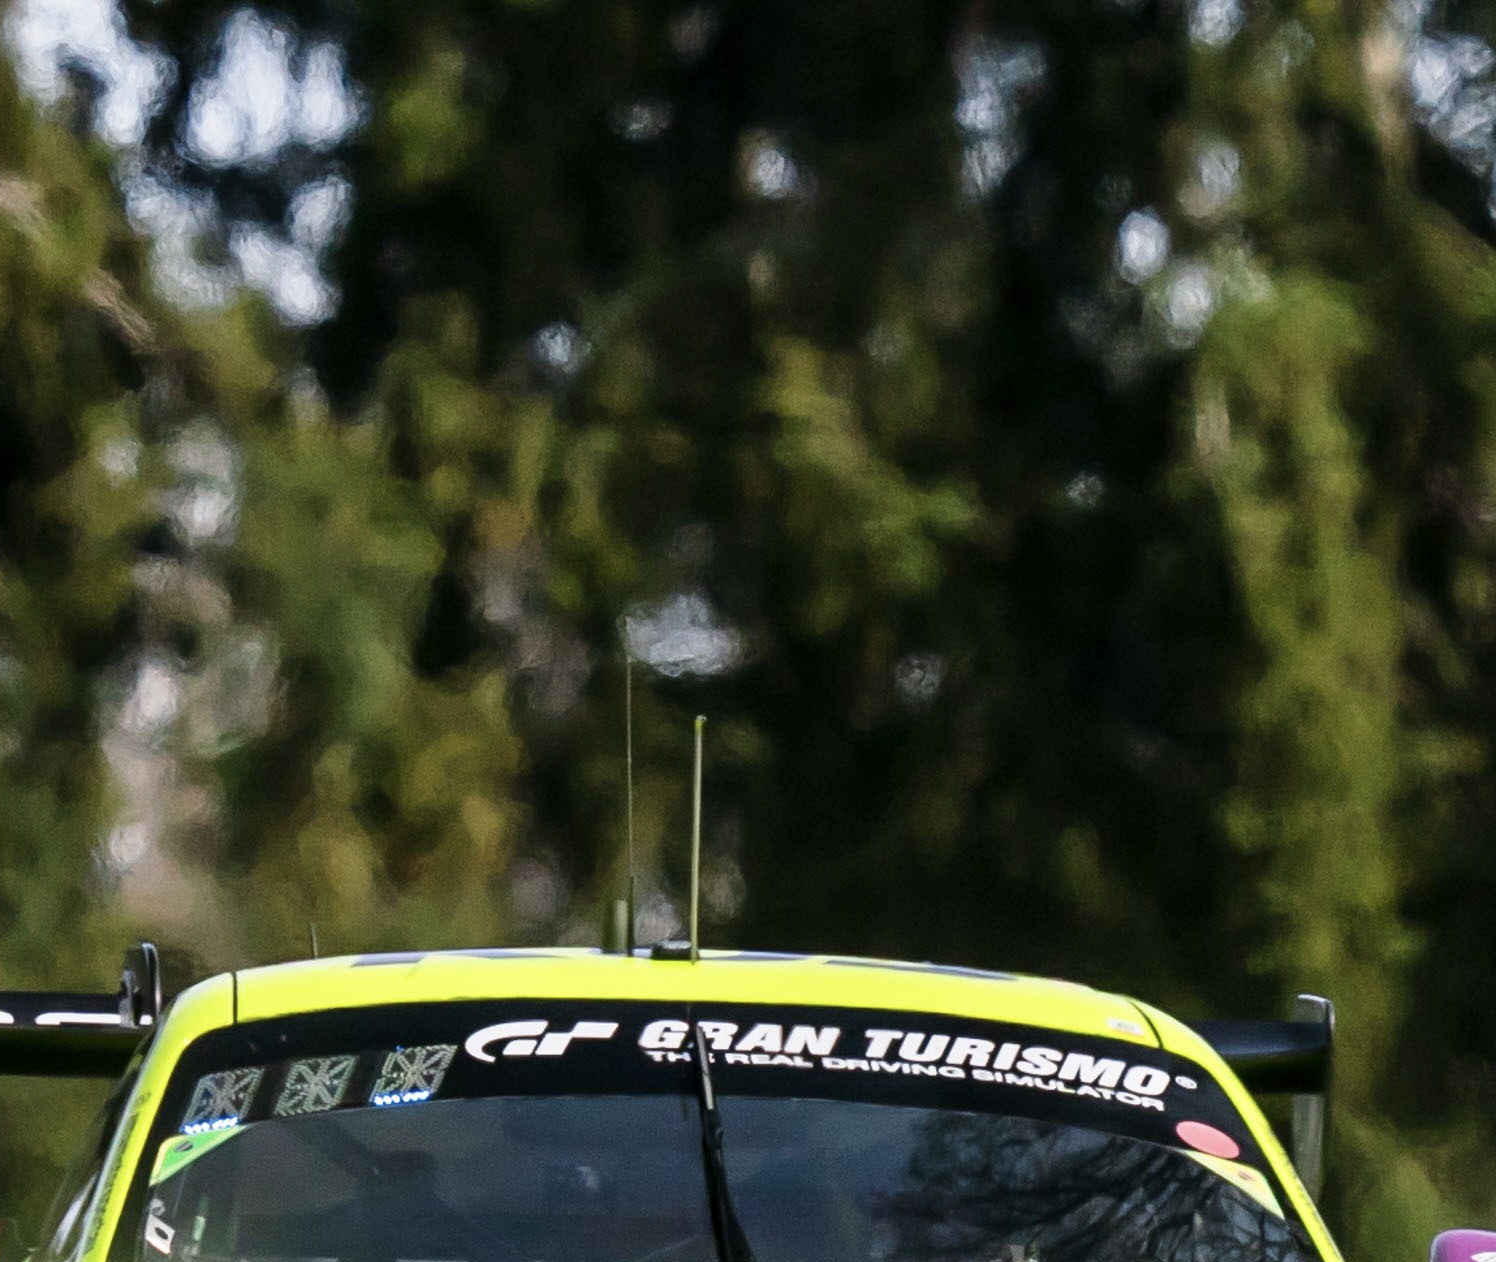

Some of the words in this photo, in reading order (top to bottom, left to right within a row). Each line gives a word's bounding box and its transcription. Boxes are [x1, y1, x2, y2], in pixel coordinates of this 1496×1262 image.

[638, 1019, 841, 1056] GRAN
[646, 1050, 714, 1063] TH
[726, 1053, 813, 1068] REAL
[821, 1057, 965, 1079] DRIVING
[973, 1069, 1165, 1112] SIMULATOR
